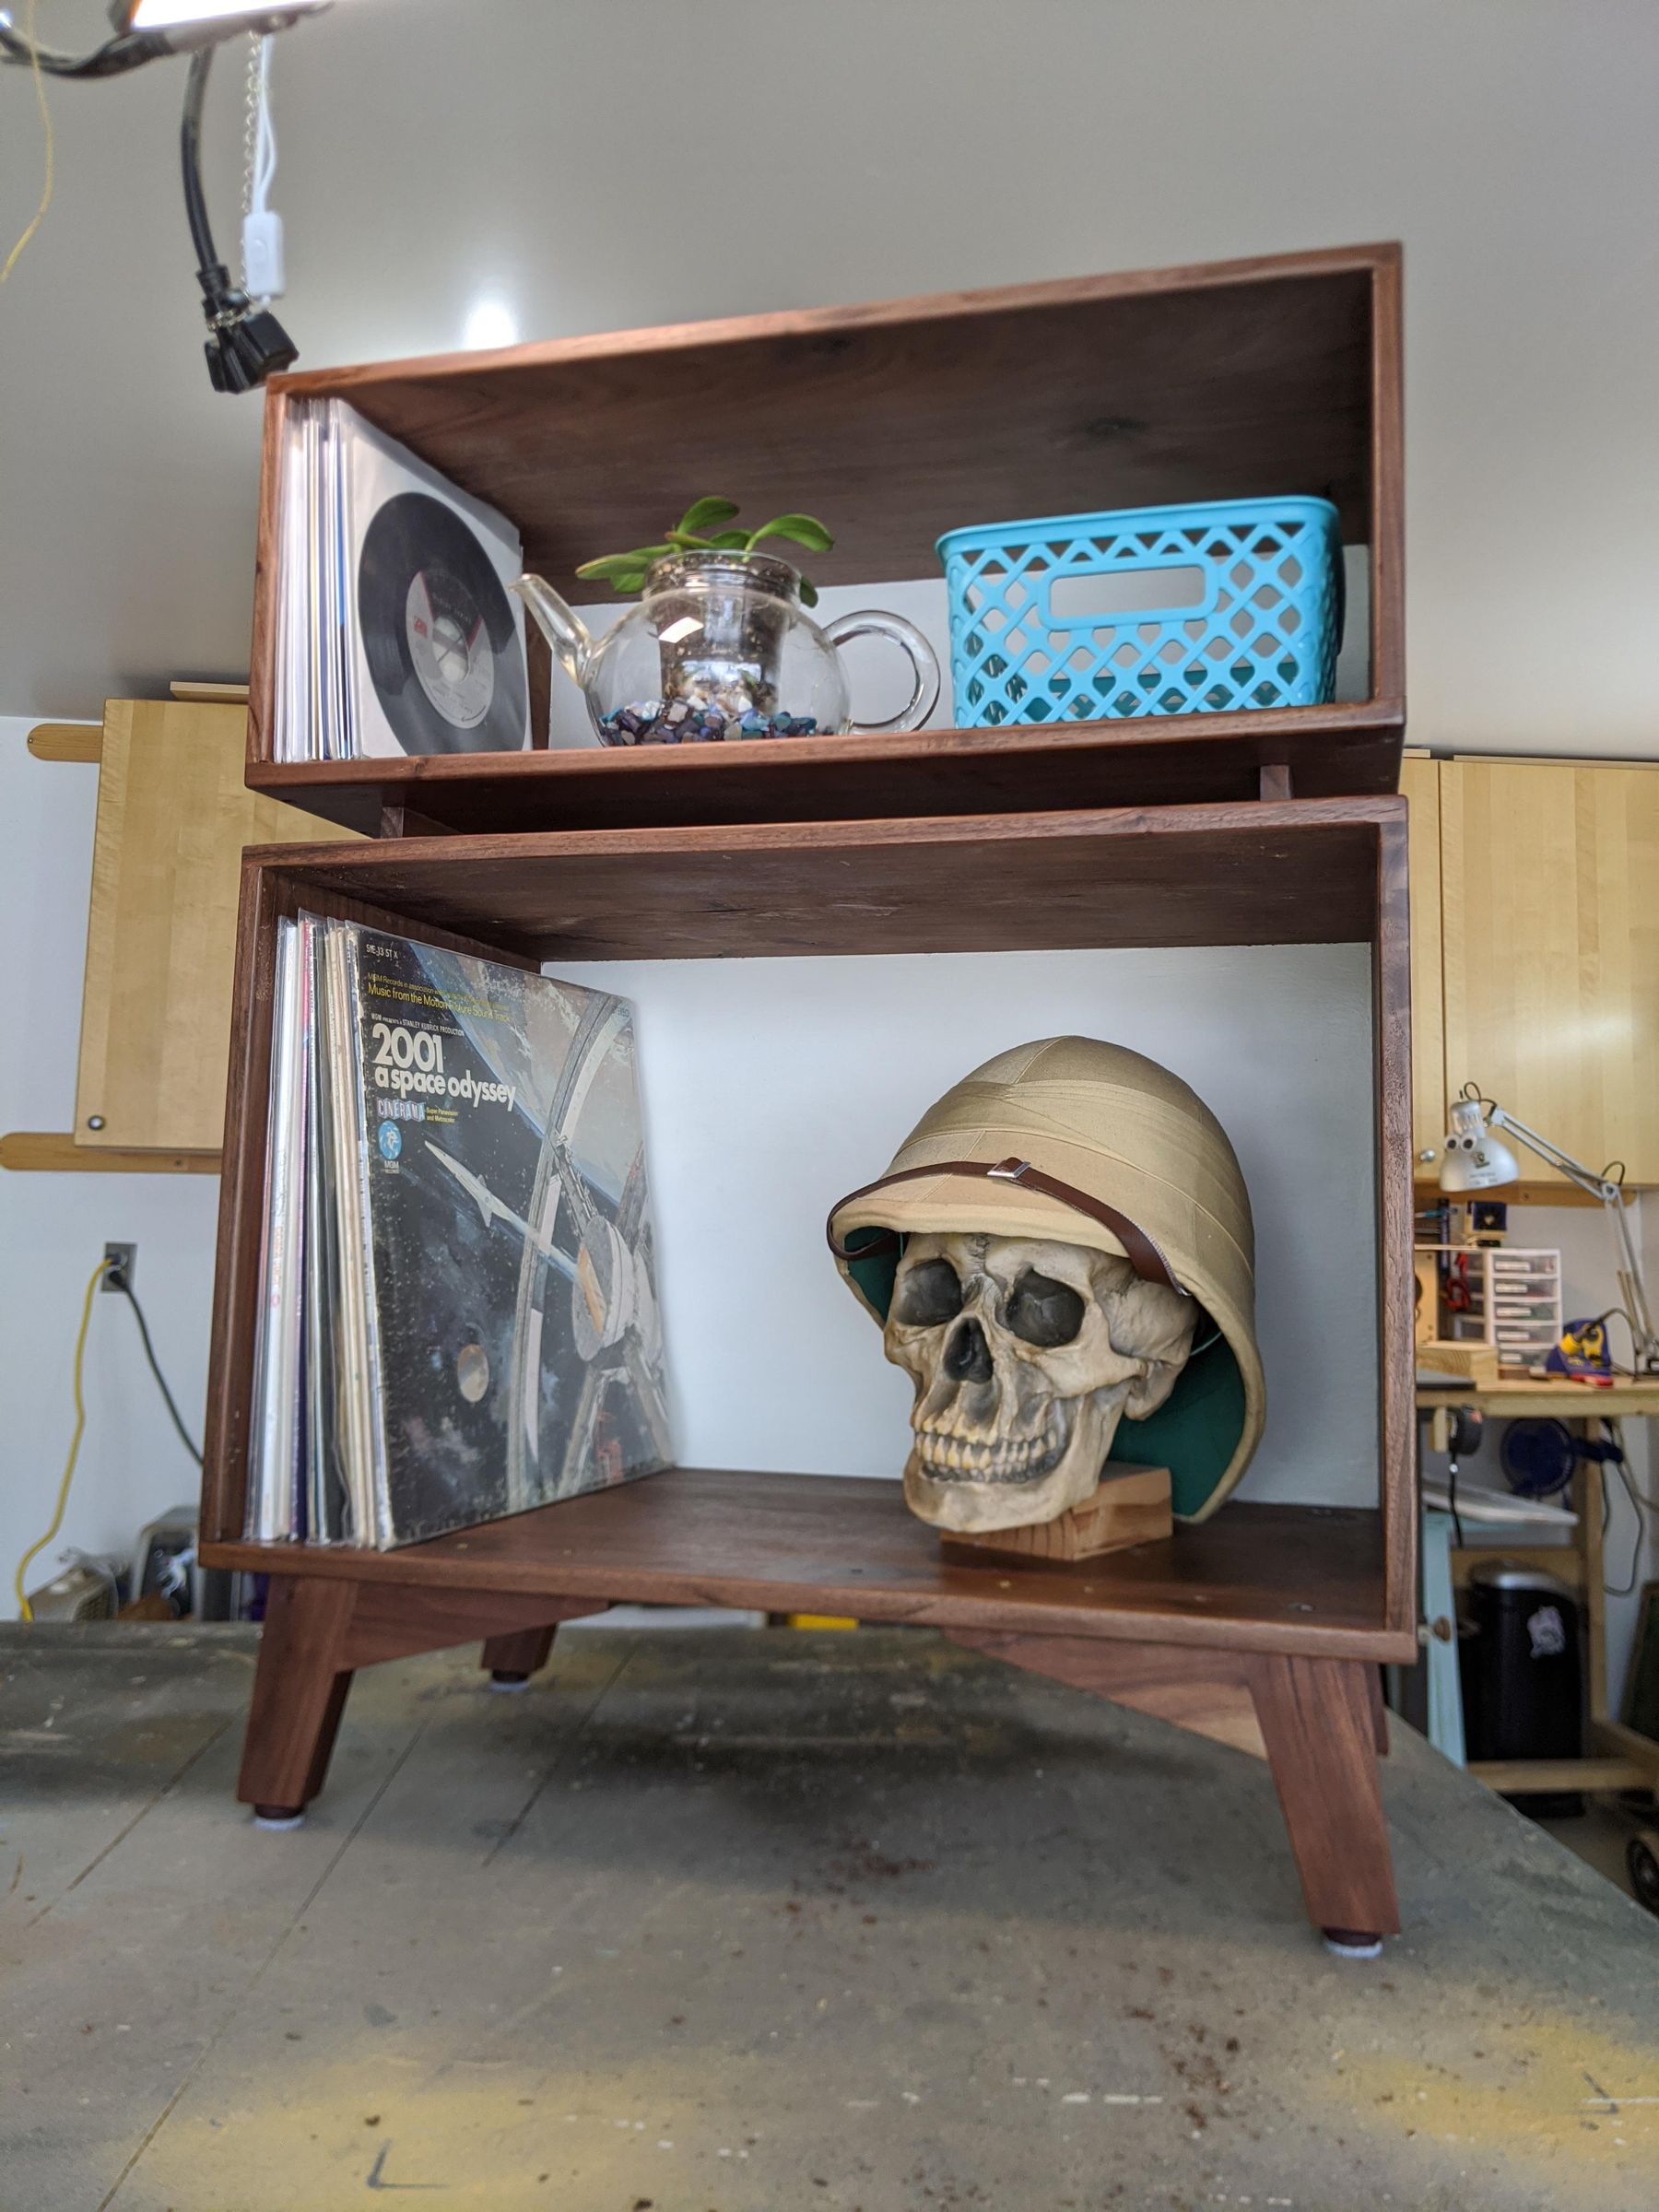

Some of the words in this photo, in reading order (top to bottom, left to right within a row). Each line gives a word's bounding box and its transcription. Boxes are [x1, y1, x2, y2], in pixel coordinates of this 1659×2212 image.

[368, 982, 392, 998] Music
[392, 986, 410, 1002] from
[410, 992, 423, 1005] the
[423, 994, 448, 1009] Motion
[402, 1018, 420, 1029] STANLEY
[420, 1022, 440, 1031] KUBRICK
[440, 1026, 465, 1037] PRODUCTION
[371, 1022, 444, 1074] 2001
[374, 1065, 389, 1088] a
[391, 1068, 447, 1099] space
[447, 1069, 516, 1112] odyssey
[377, 1098, 425, 1122] CINERAMA
